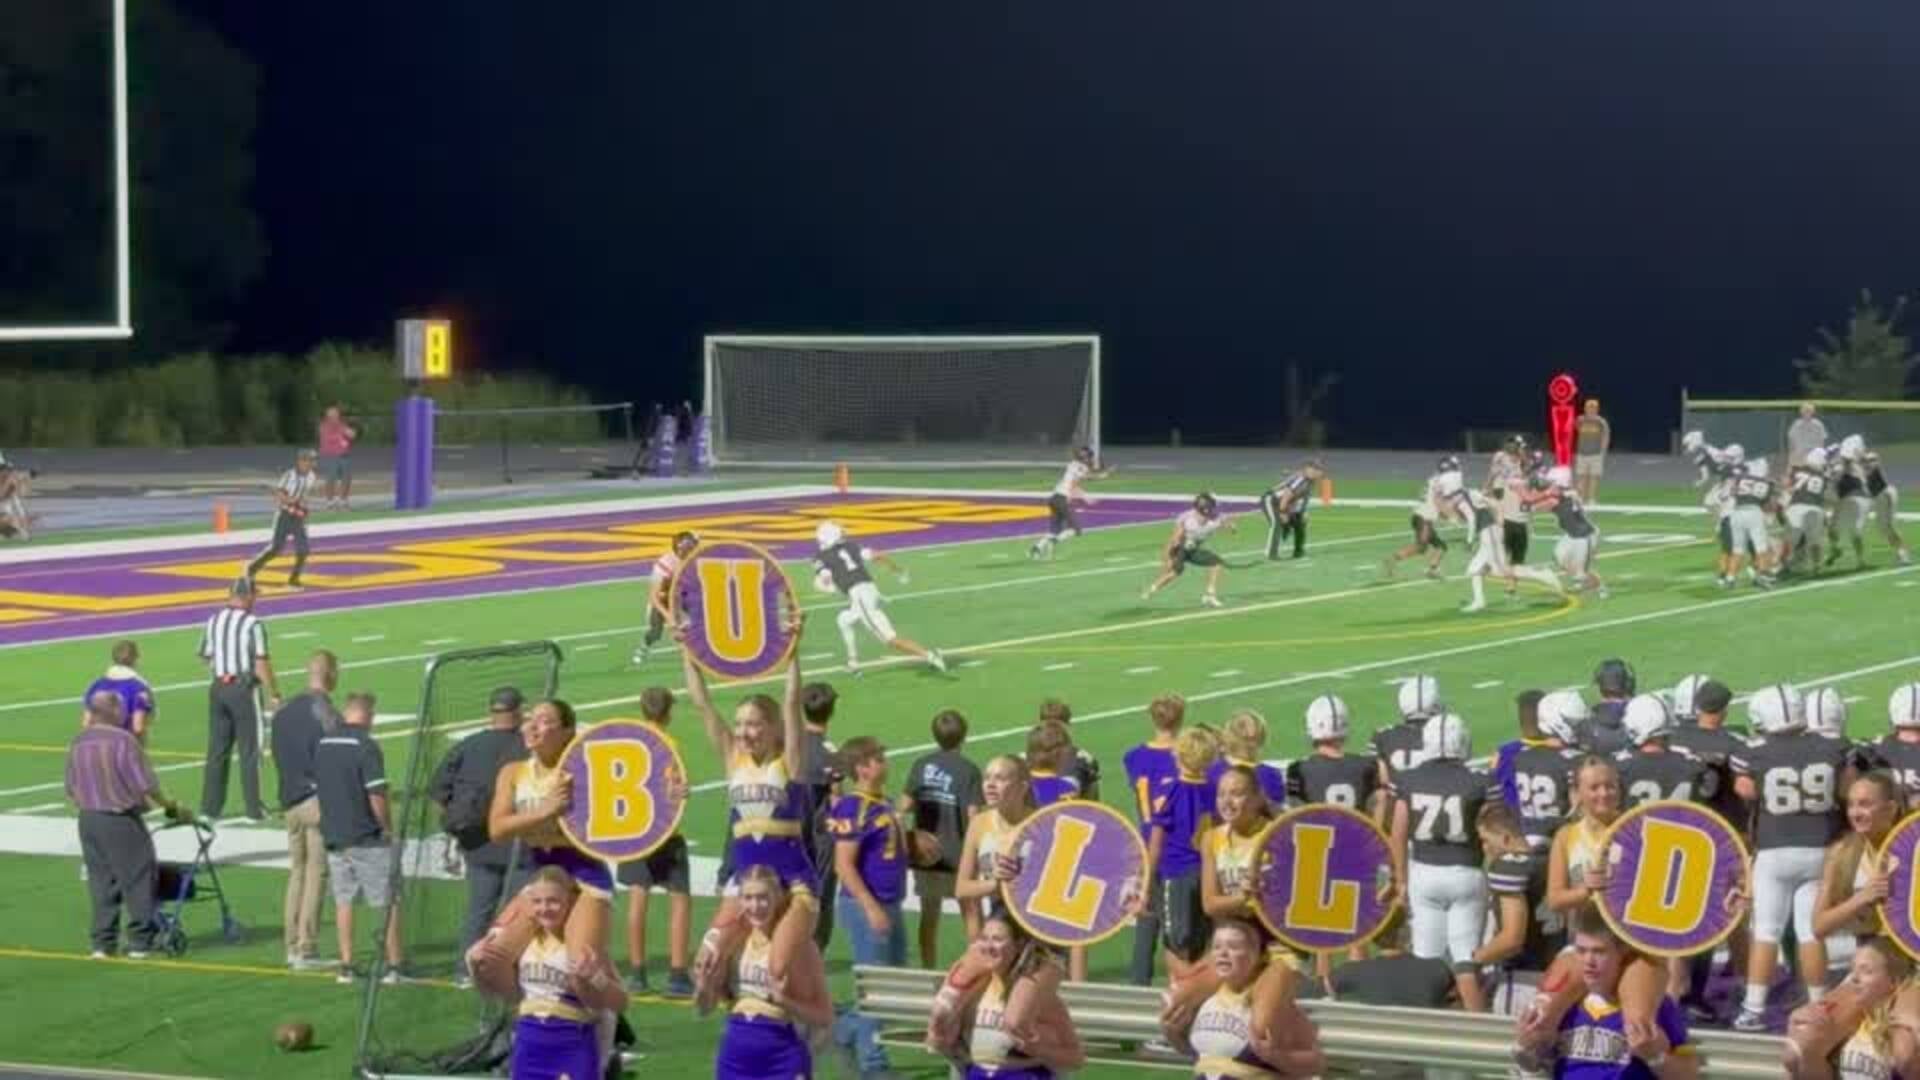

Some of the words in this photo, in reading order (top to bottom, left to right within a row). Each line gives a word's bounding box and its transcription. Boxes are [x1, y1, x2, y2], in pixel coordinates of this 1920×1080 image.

[697, 558, 765, 662] U
[838, 549, 858, 572] 1
[583, 738, 655, 842] B
[1411, 793, 1469, 842] 71
[1763, 762, 1834, 815] 69
[1026, 814, 1107, 931] L
[1285, 823, 1361, 934] L
[1622, 816, 1716, 935] D
